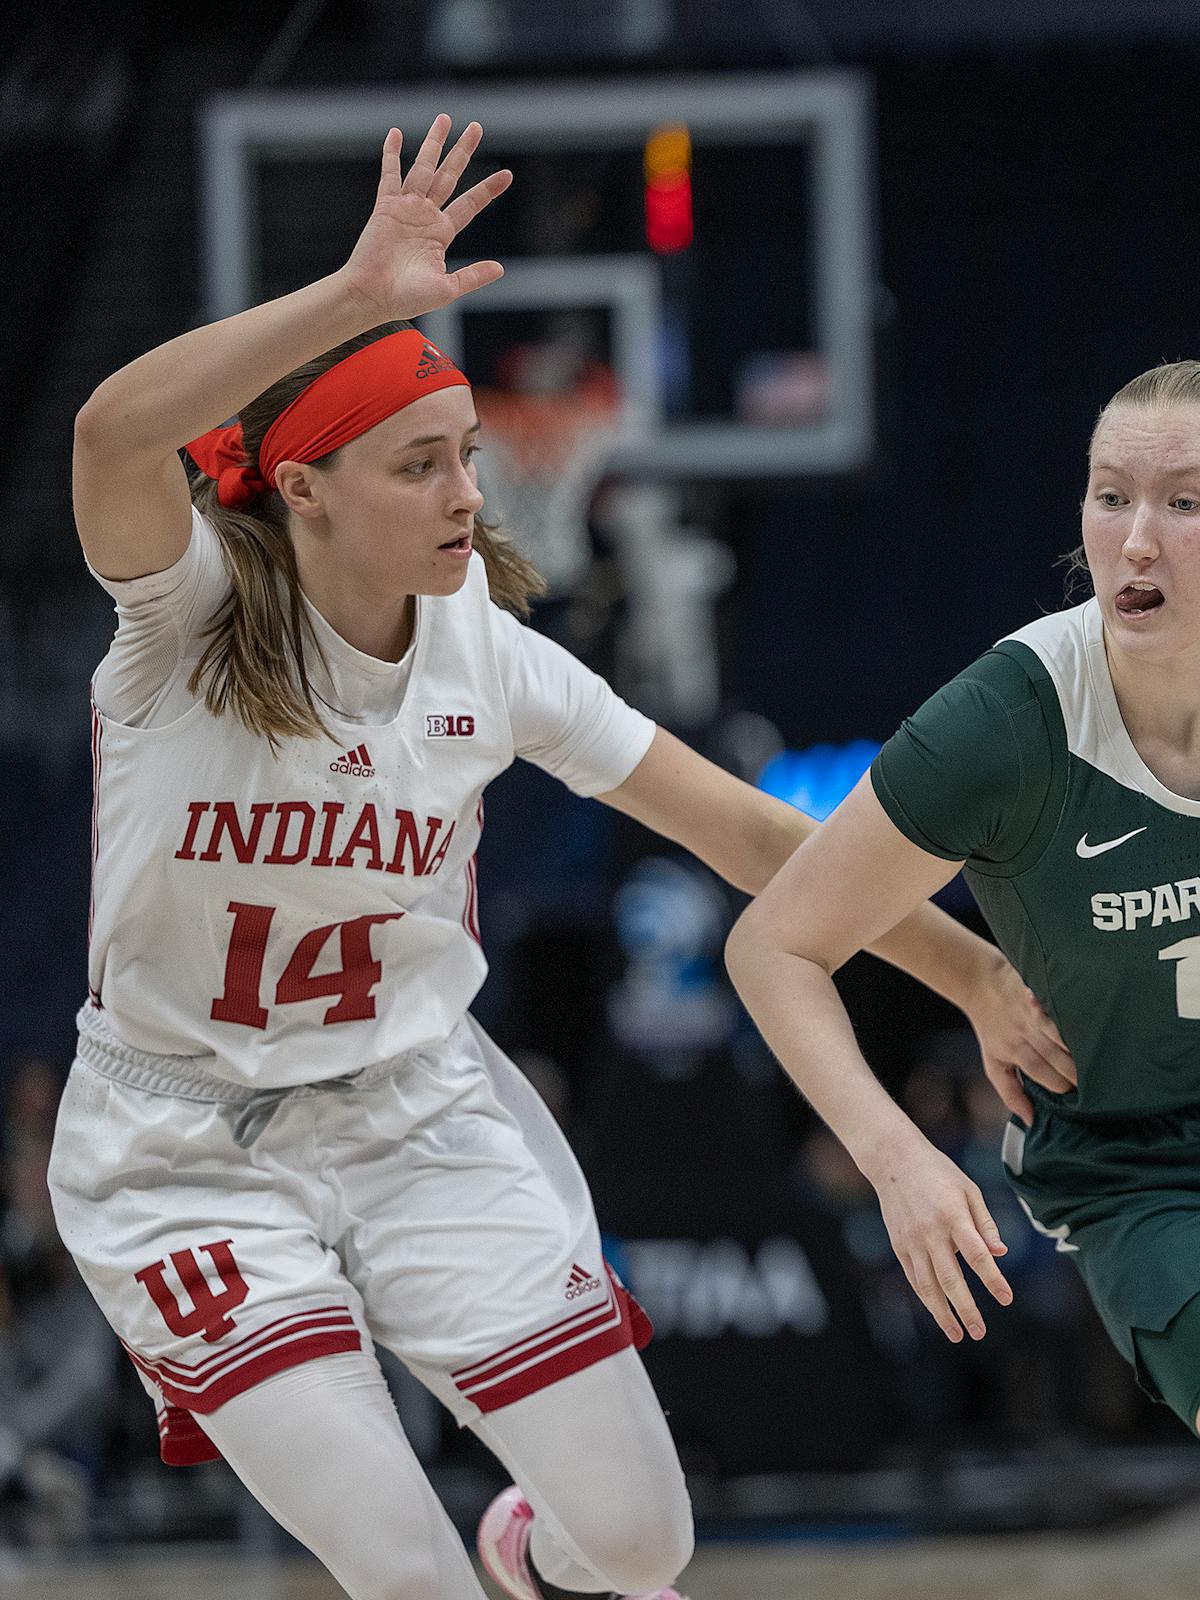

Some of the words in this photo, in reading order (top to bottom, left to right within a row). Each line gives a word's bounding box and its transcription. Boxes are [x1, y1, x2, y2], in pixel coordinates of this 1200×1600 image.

[329, 762, 376, 778] adidas
[174, 801, 456, 877] INDIANA
[210, 901, 405, 1030] 14
